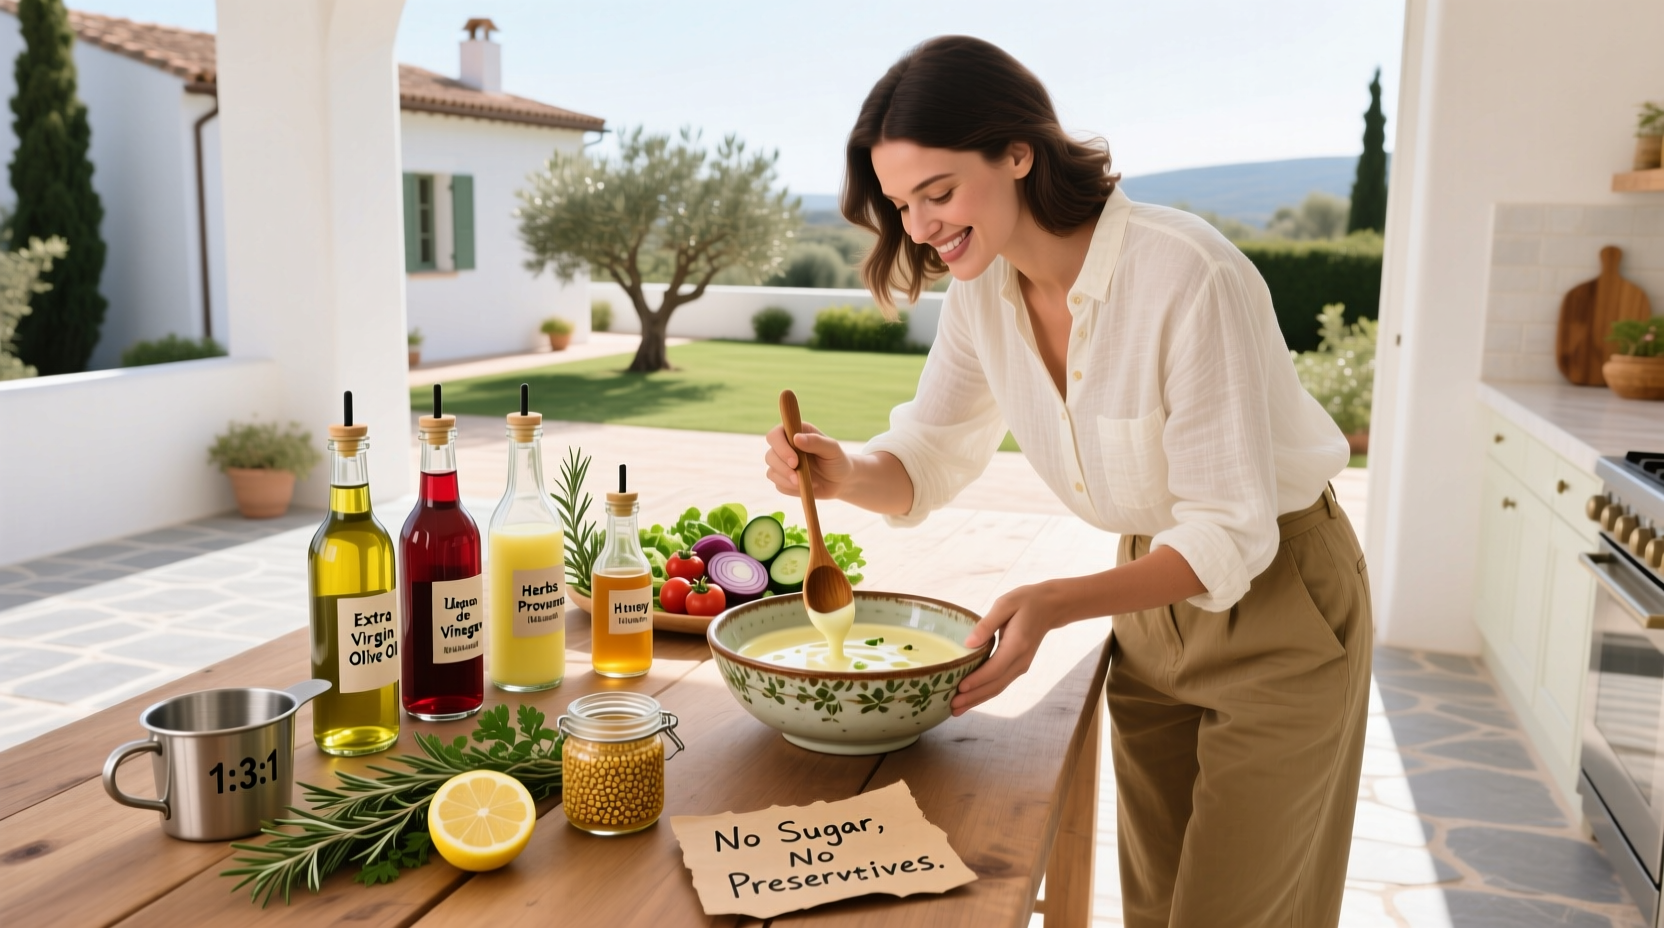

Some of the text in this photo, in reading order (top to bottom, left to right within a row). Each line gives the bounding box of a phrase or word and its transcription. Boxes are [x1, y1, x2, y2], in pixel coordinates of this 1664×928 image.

[522, 581, 559, 597] Herbs
[354, 611, 392, 627] Extra
[456, 611, 471, 622] de
[351, 627, 394, 648] Virgin
[349, 650, 383, 666] Olive
[209, 748, 277, 794] 1:3:1
[715, 819, 884, 852] No Sugar,
[790, 848, 834, 867] No
[728, 855, 945, 899] Preservtives.
